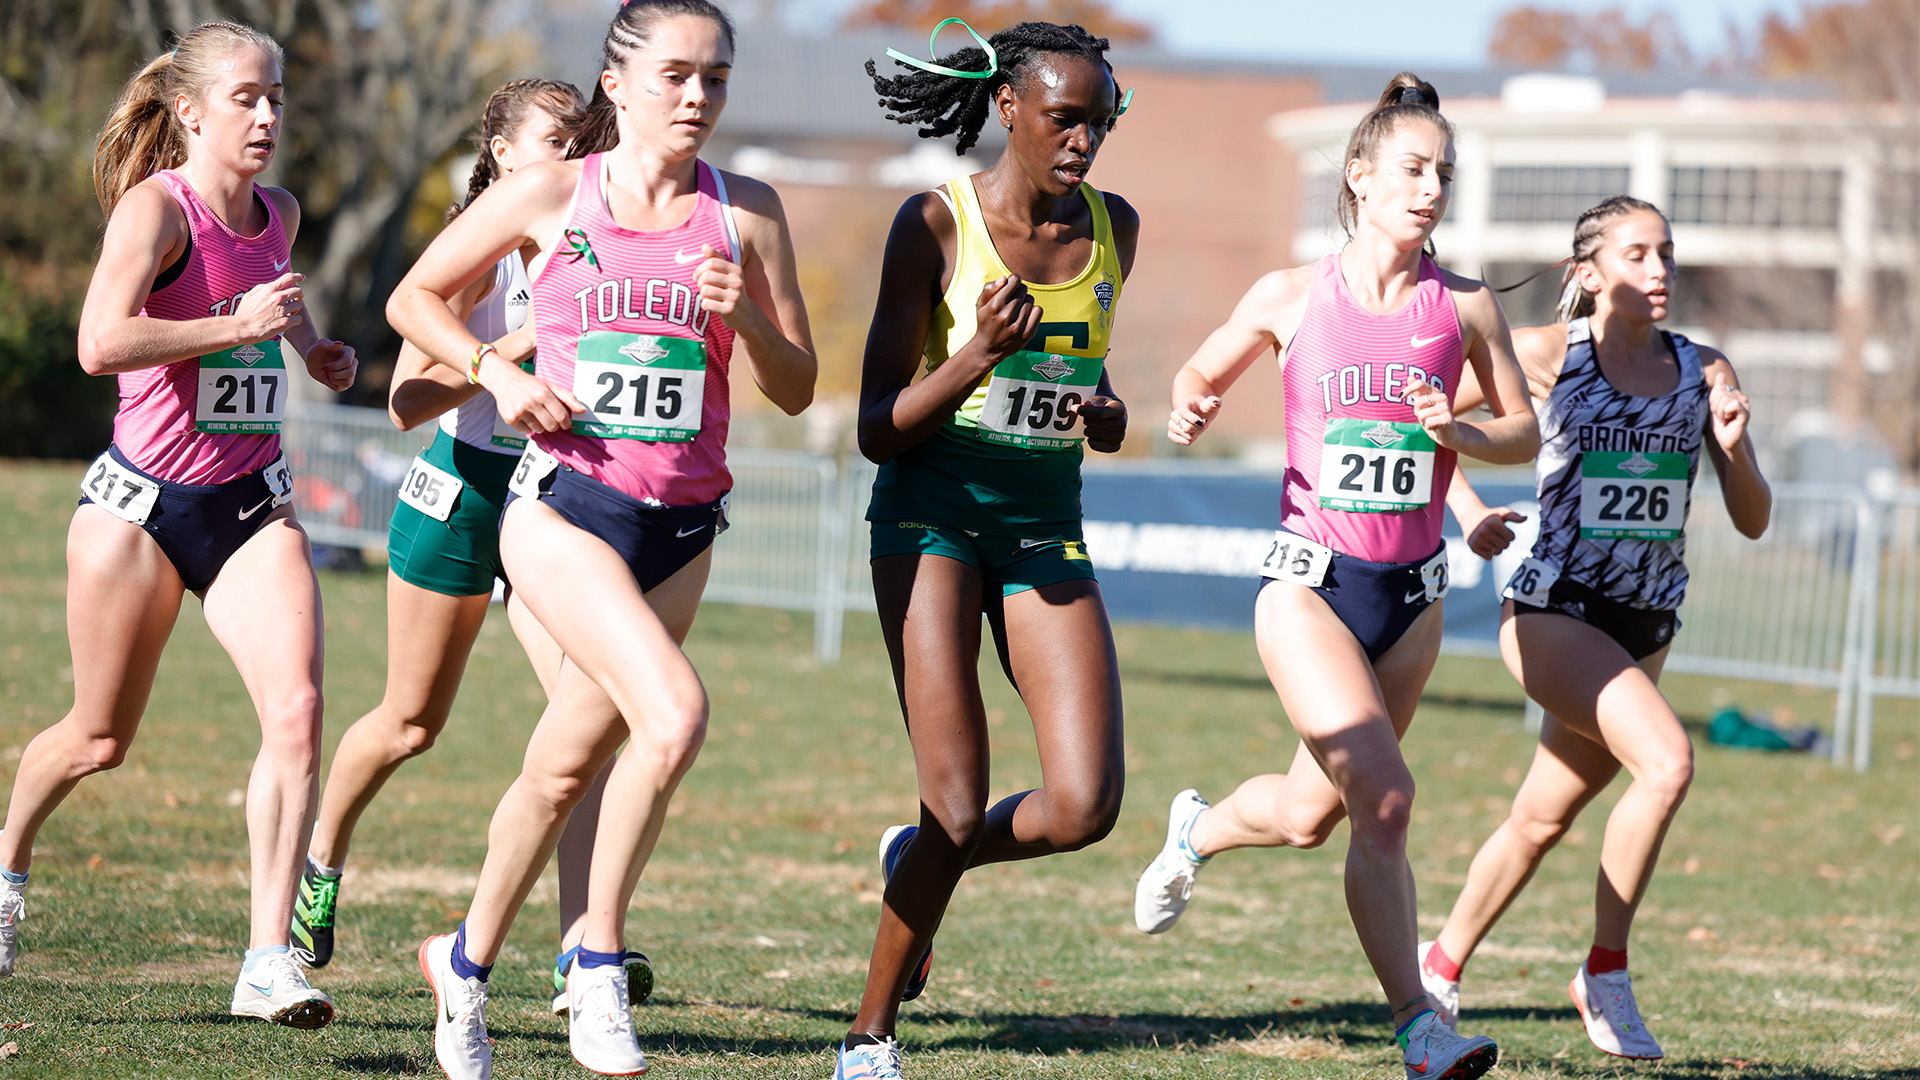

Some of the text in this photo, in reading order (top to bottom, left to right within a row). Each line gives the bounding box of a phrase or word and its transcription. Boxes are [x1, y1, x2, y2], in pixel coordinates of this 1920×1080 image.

[213, 374, 278, 414] 217
[594, 371, 682, 420] 215
[1007, 386, 1082, 432] 159
[1563, 402, 1594, 411] adidas
[1027, 438, 1051, 447] OCTOBER
[1578, 425, 1690, 454] BRONCOS
[89, 462, 142, 510] 217
[405, 466, 444, 507] 195
[1338, 453, 1416, 495] 216
[1598, 485, 1669, 522] 226
[1262, 540, 1314, 577] 216
